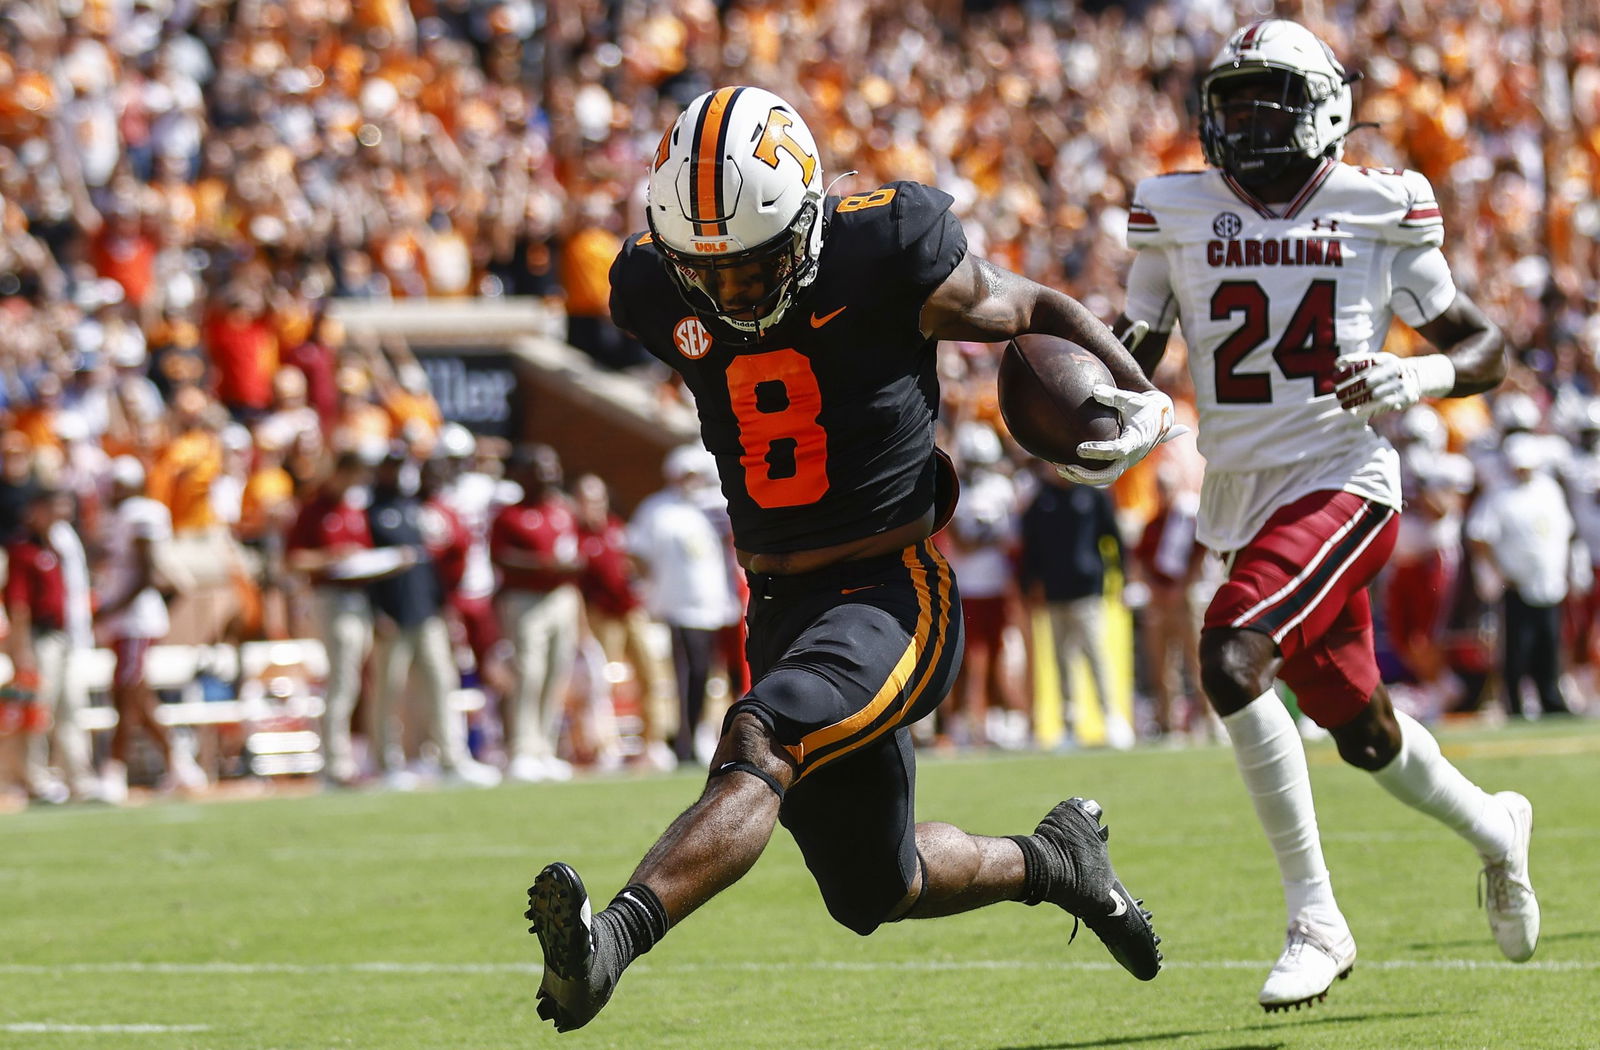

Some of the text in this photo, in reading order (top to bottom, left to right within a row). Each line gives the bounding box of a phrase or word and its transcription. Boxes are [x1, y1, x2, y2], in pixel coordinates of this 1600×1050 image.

[836, 188, 896, 213] 8
[1214, 213, 1241, 237] SEC
[695, 242, 728, 252] VOLS
[1207, 238, 1343, 267] CAROLINA
[676, 319, 709, 356] SEC
[1210, 278, 1340, 404] 24
[725, 348, 830, 508] 8
